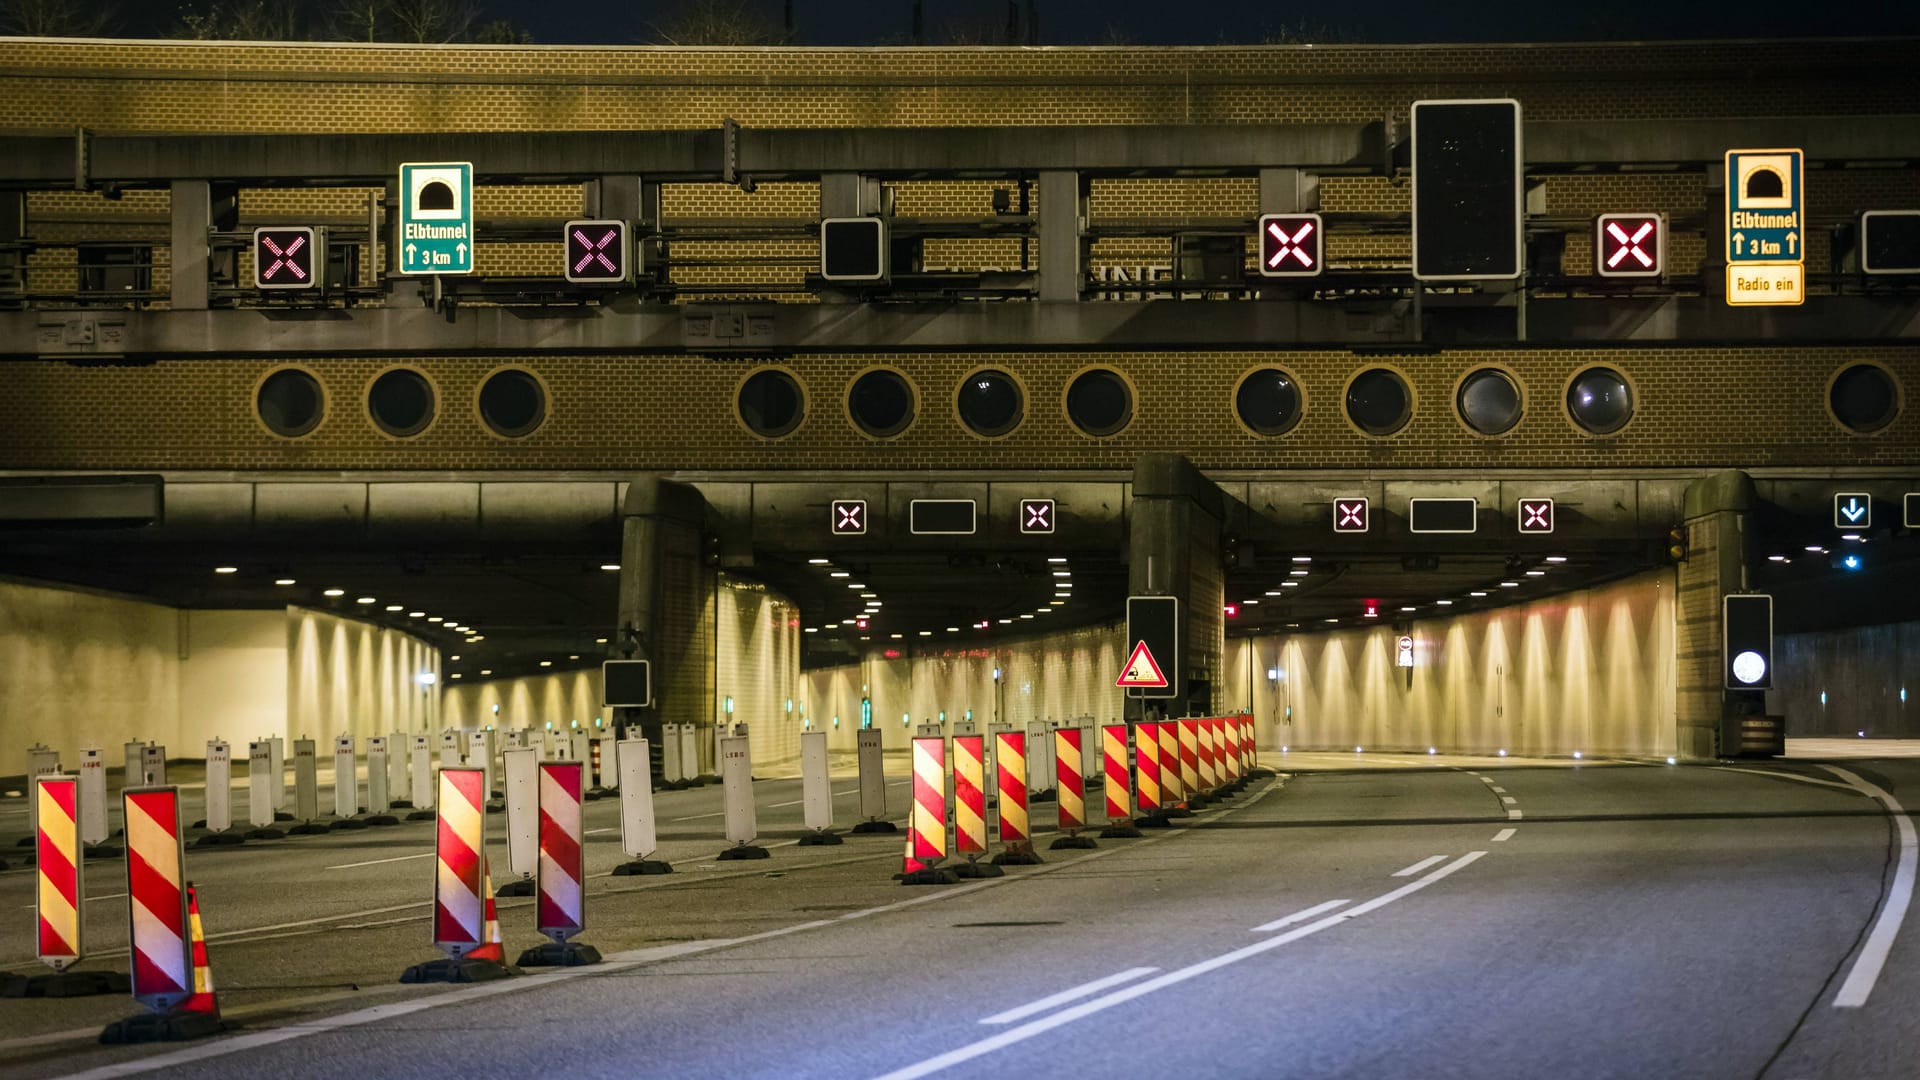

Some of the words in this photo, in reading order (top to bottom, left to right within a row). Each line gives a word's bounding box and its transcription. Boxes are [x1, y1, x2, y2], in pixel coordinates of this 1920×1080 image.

[1732, 211, 1798, 229] Elbtunnel
[405, 222, 467, 240] Elbtunnel
[1750, 239, 1759, 255] 3
[1761, 239, 1781, 255] km
[422, 250, 430, 265] 3
[432, 249, 451, 265] km
[1737, 277, 1770, 291] Radio
[1775, 277, 1794, 291] ein
